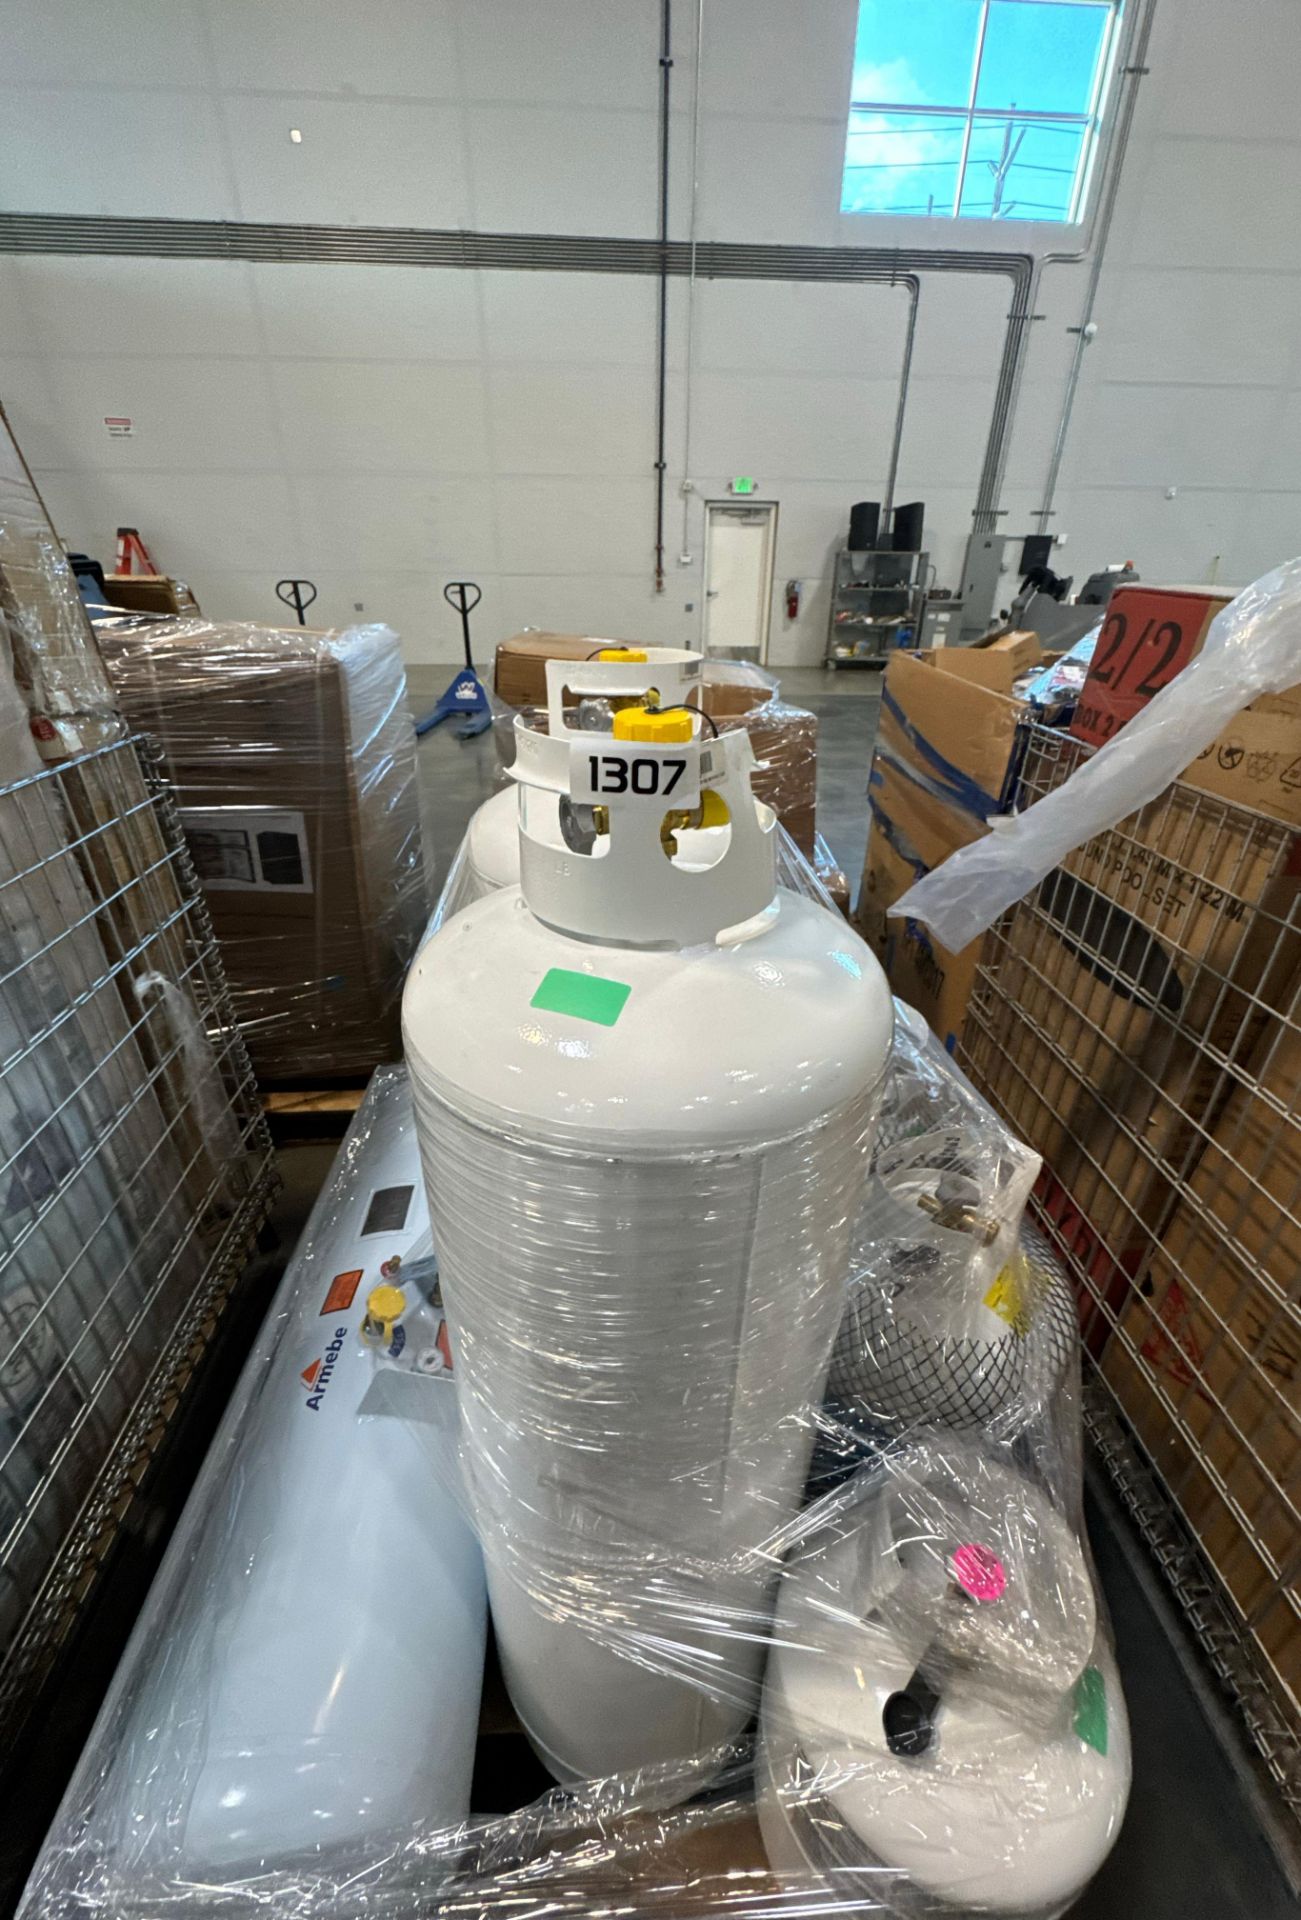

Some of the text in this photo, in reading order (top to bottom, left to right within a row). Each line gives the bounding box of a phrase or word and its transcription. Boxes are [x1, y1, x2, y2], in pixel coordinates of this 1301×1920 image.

[1088, 612, 1182, 698] 2/2
[588, 756, 687, 796] 1307
[1110, 860, 1152, 903] POO
[1152, 887, 1187, 918] SET
[1188, 876, 1224, 911] 122
[306, 1327, 348, 1411] Armebe
